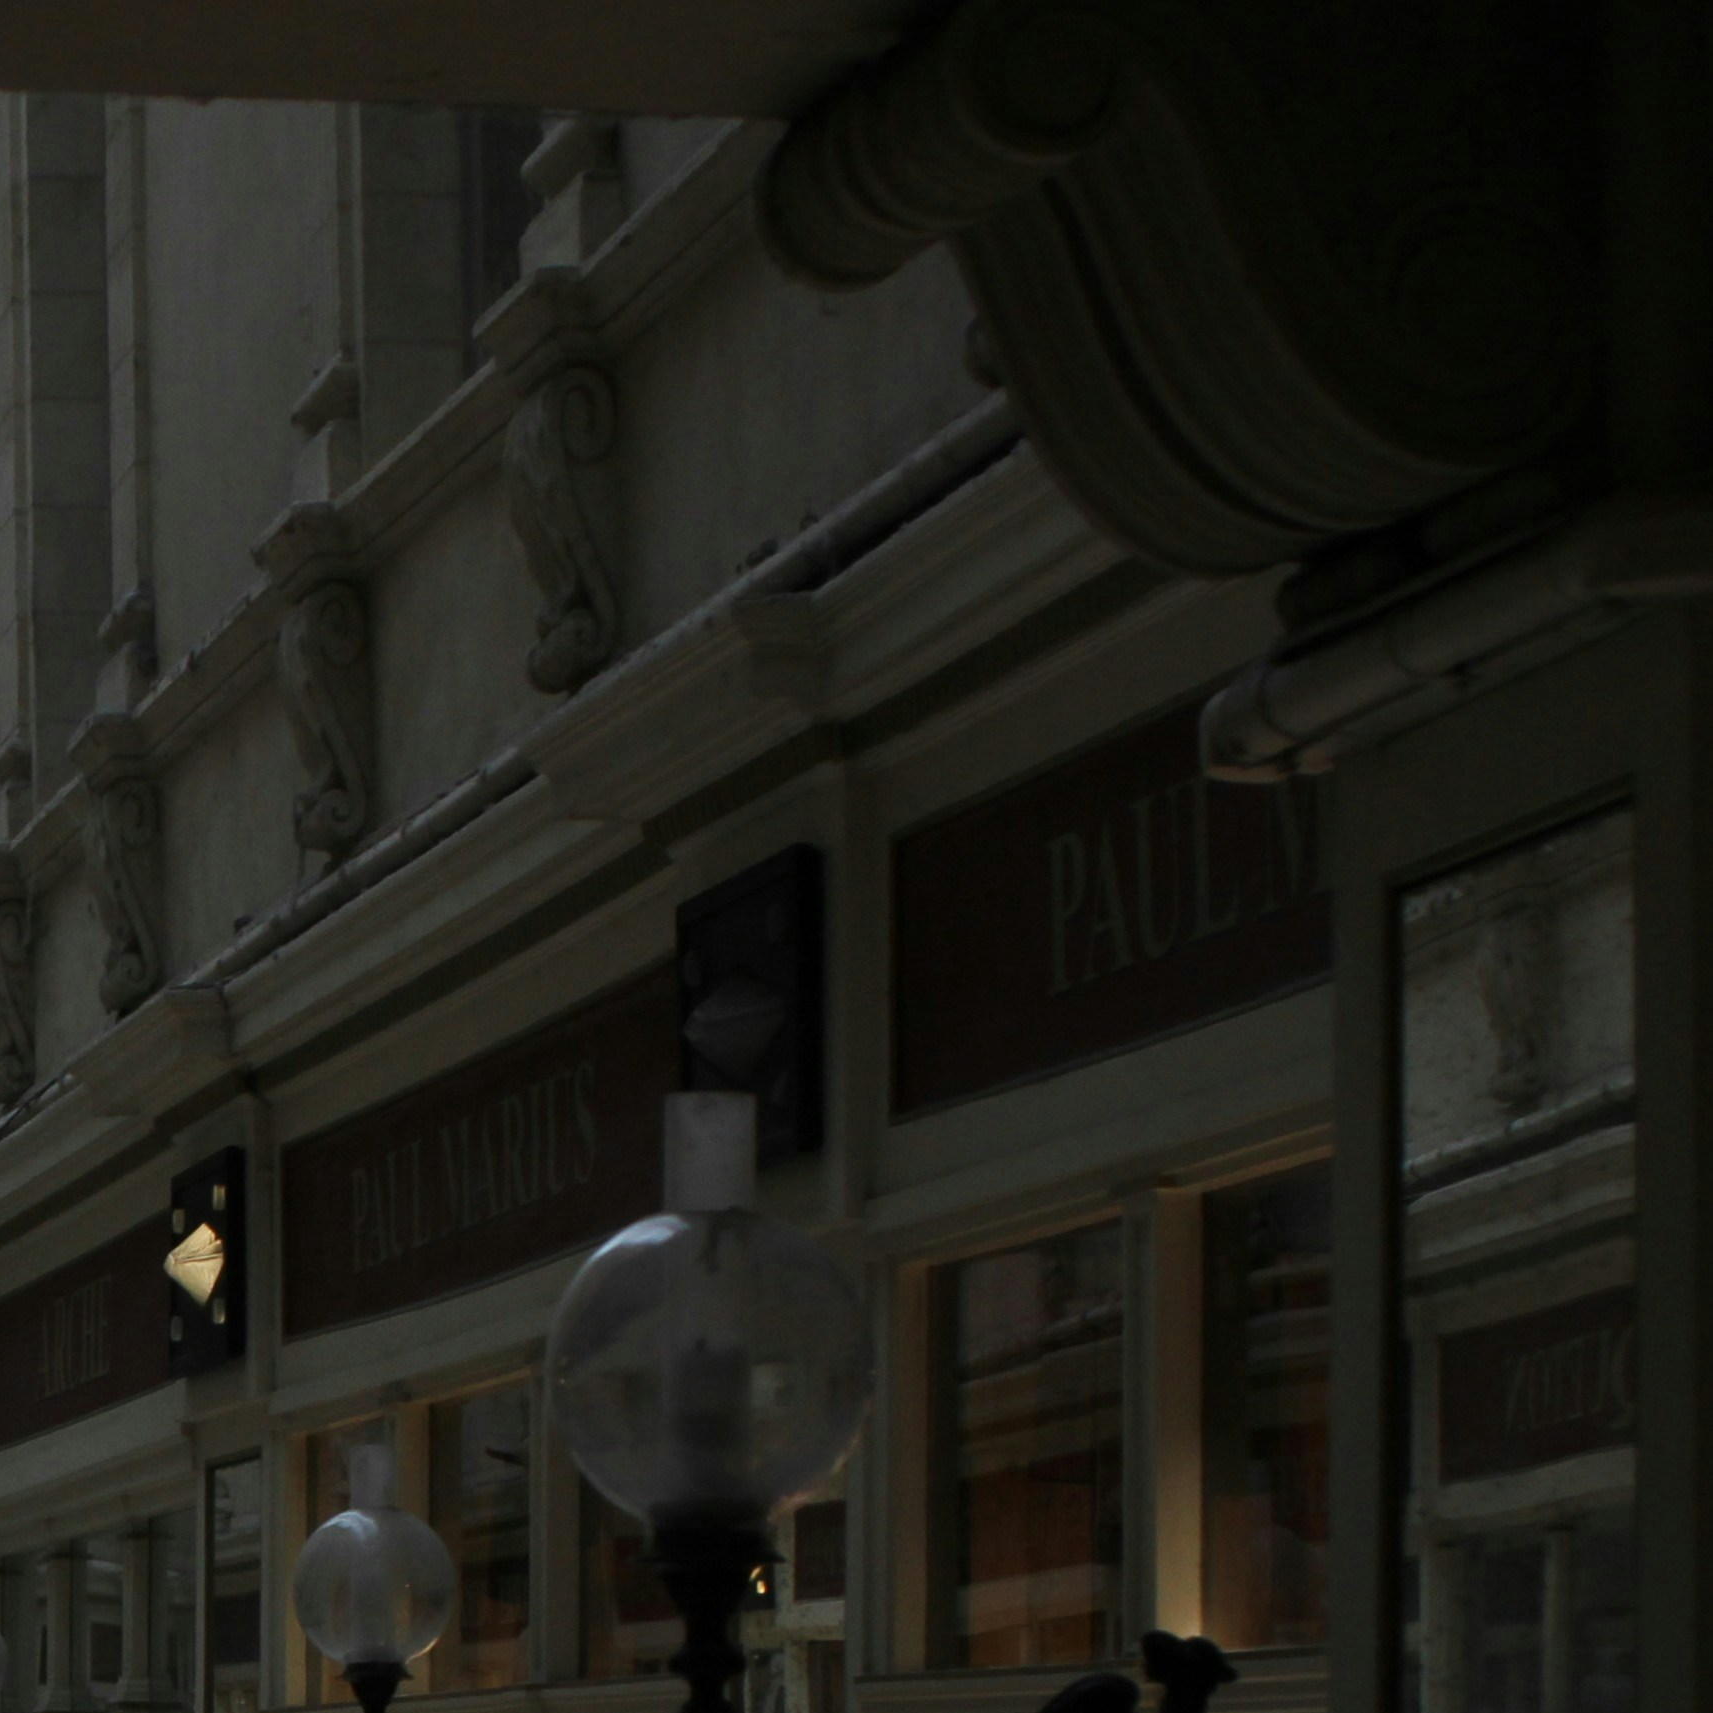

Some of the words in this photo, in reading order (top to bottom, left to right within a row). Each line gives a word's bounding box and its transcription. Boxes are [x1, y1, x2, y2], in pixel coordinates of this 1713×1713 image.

[1047, 774, 1242, 996] PAUL
[350, 1138, 433, 1274] PAUL
[440, 1058, 599, 1246] MARIUS
[36, 1275, 111, 1404] ARCHE
